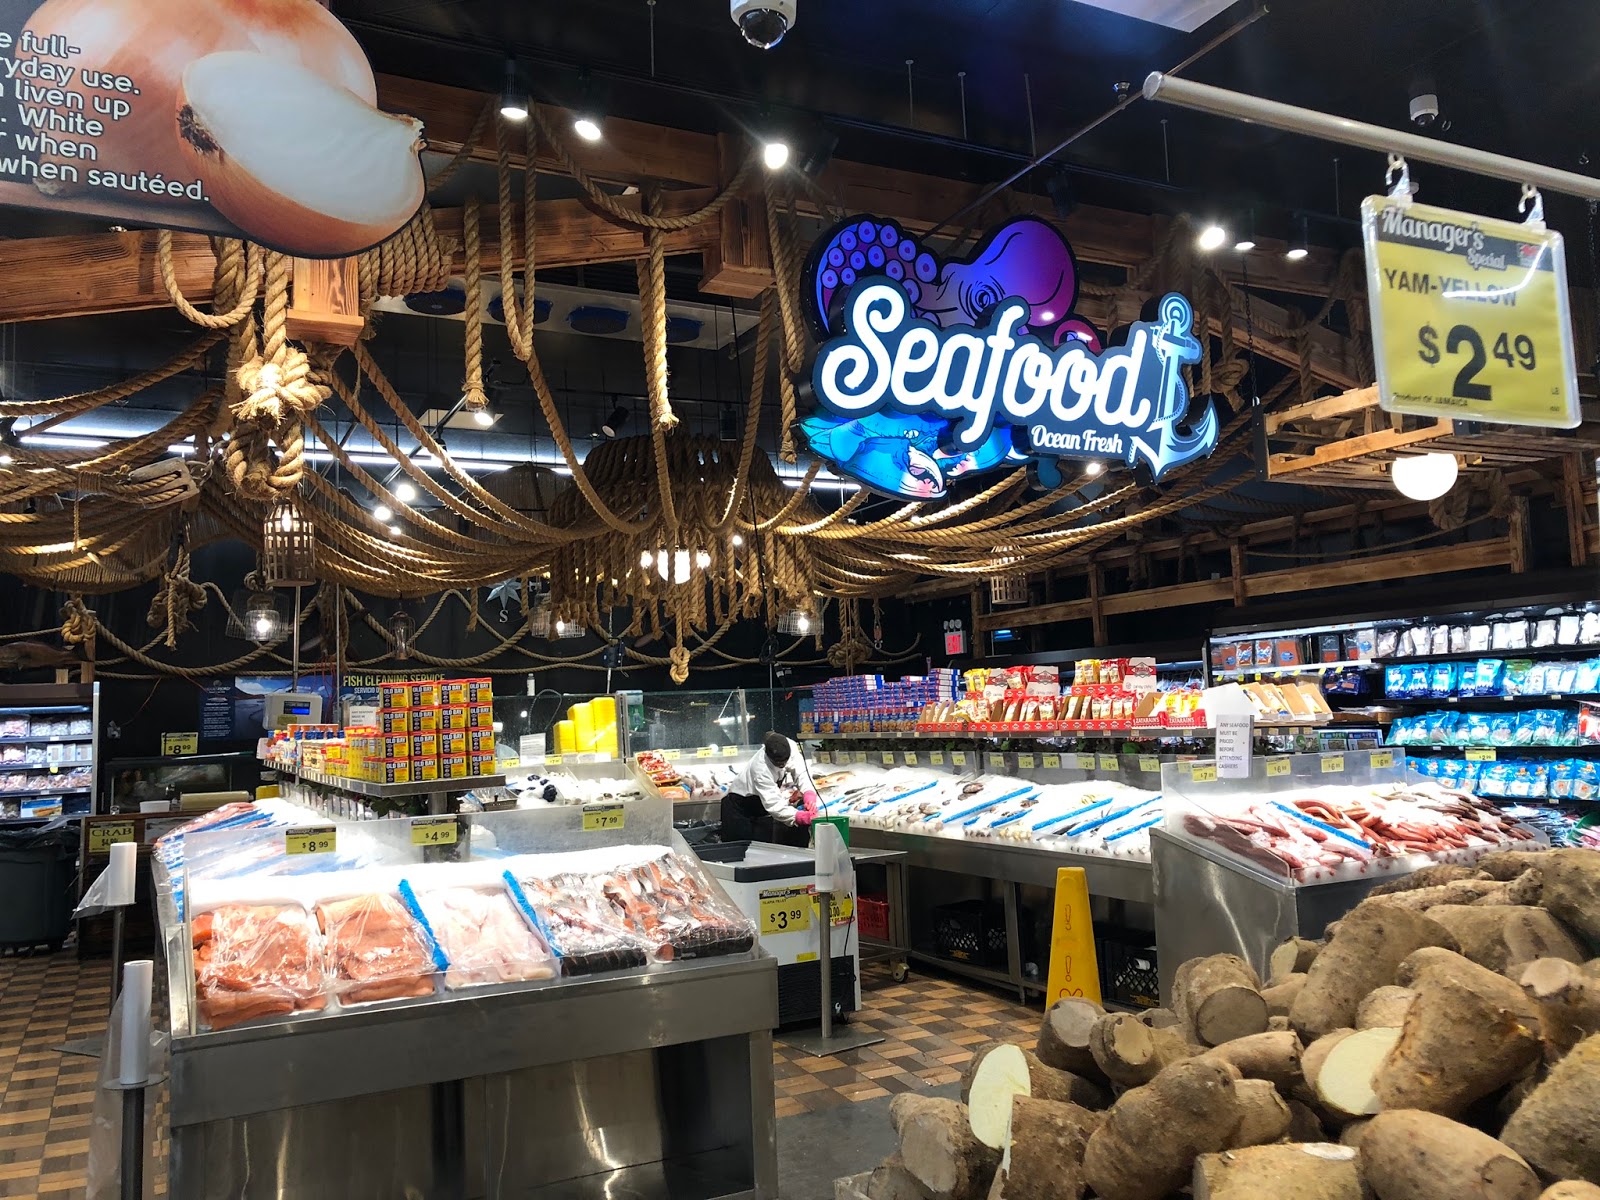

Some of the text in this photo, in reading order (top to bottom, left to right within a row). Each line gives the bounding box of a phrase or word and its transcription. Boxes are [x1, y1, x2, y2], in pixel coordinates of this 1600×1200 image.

[22, 32, 80, 57] full-
[0, 57, 140, 94] yday use.
[15, 79, 84, 110] liven
[93, 96, 130, 120] up
[18, 104, 103, 136] White
[15, 133, 97, 160] when
[0, 155, 210, 201] when sautéed.
[1382, 207, 1484, 250] Manager's
[821, 285, 1151, 443] Seafood
[1031, 425, 1123, 454] Ocean Fresh
[343, 675, 362, 687] FISH
[364, 674, 408, 686] CLEANING
[92, 828, 132, 836] CRAB
